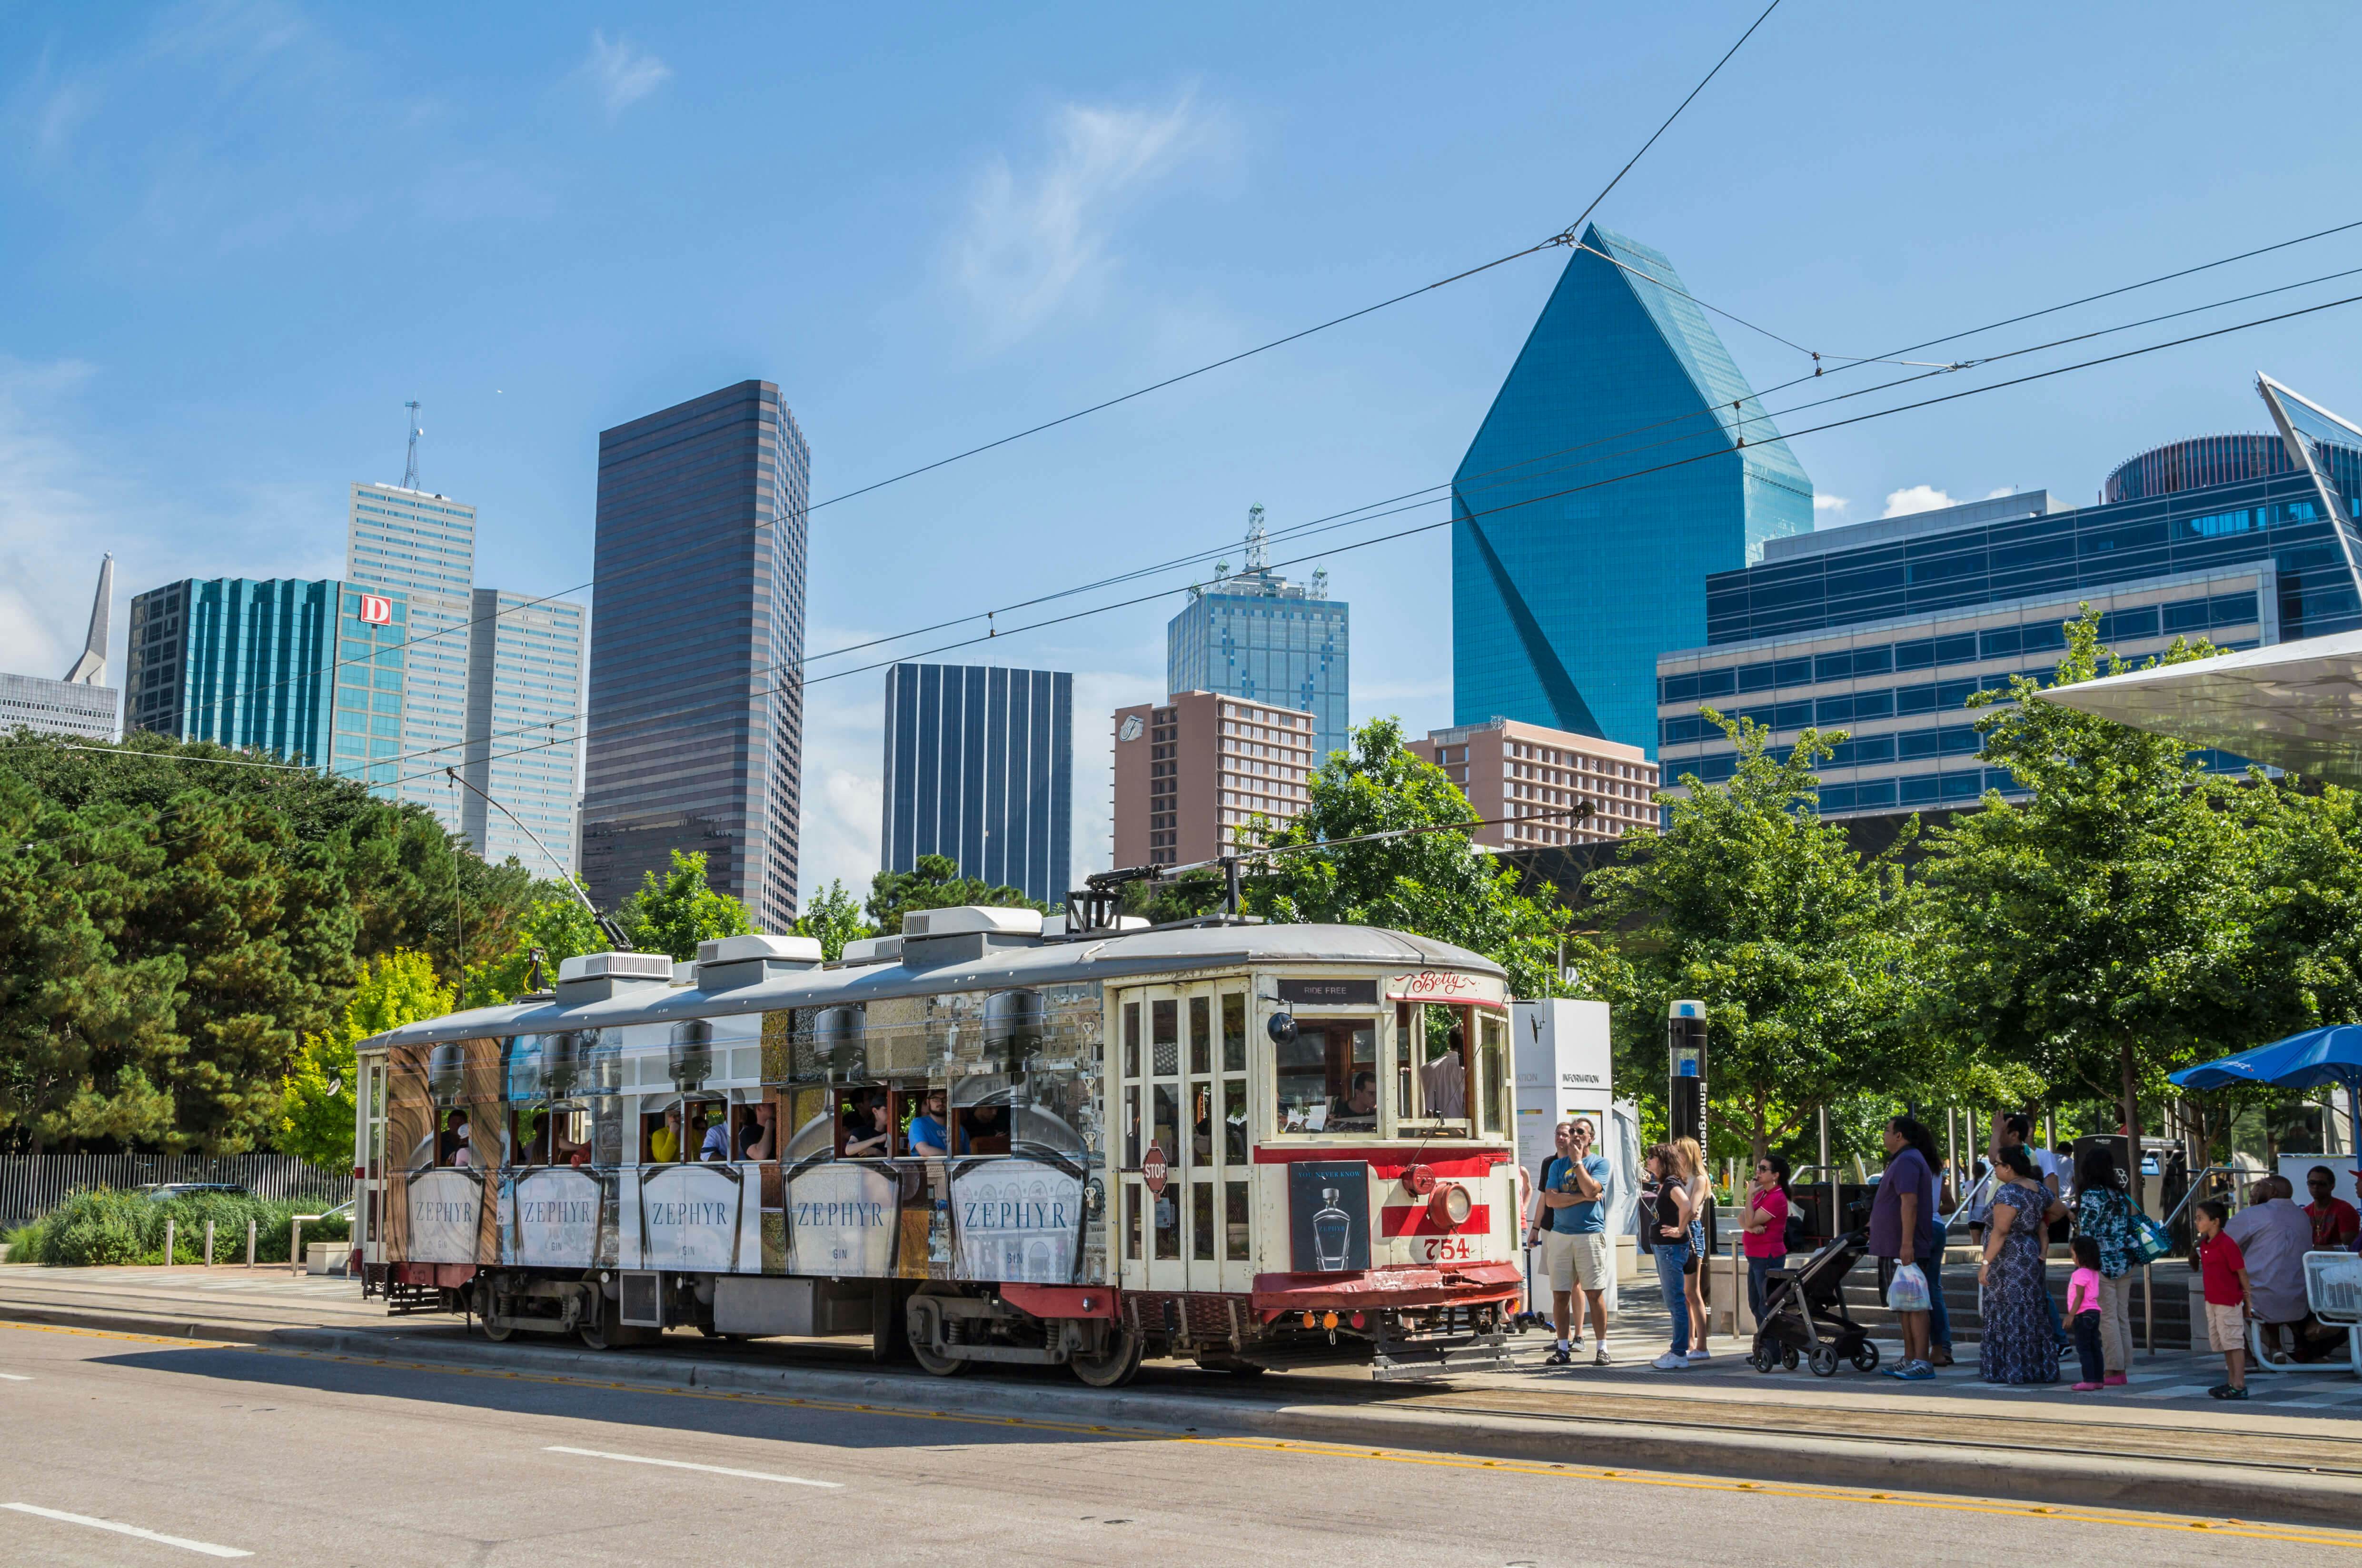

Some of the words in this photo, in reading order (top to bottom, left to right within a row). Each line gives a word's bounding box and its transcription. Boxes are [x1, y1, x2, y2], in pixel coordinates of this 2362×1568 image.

[364, 596, 389, 622] D
[1412, 970, 1466, 994] Betty
[1562, 1073, 1600, 1083] INFORMATION
[1698, 1082, 1708, 1167] Emergency
[1145, 1163, 1166, 1178] STOP
[416, 1201, 472, 1222] ZEPHYR
[525, 1201, 590, 1222] ZEPHYR
[653, 1202, 727, 1225] ZEPHYR
[798, 1202, 883, 1226] ZEPHYR
[965, 1202, 1066, 1228] ZEPHYR
[438, 1241, 447, 1249] GIN
[551, 1242, 562, 1251] GIN
[683, 1245, 695, 1256] GIN
[834, 1249, 847, 1259] GIN
[1424, 1238, 1470, 1260] 754
[1007, 1252, 1023, 1264] GIN
